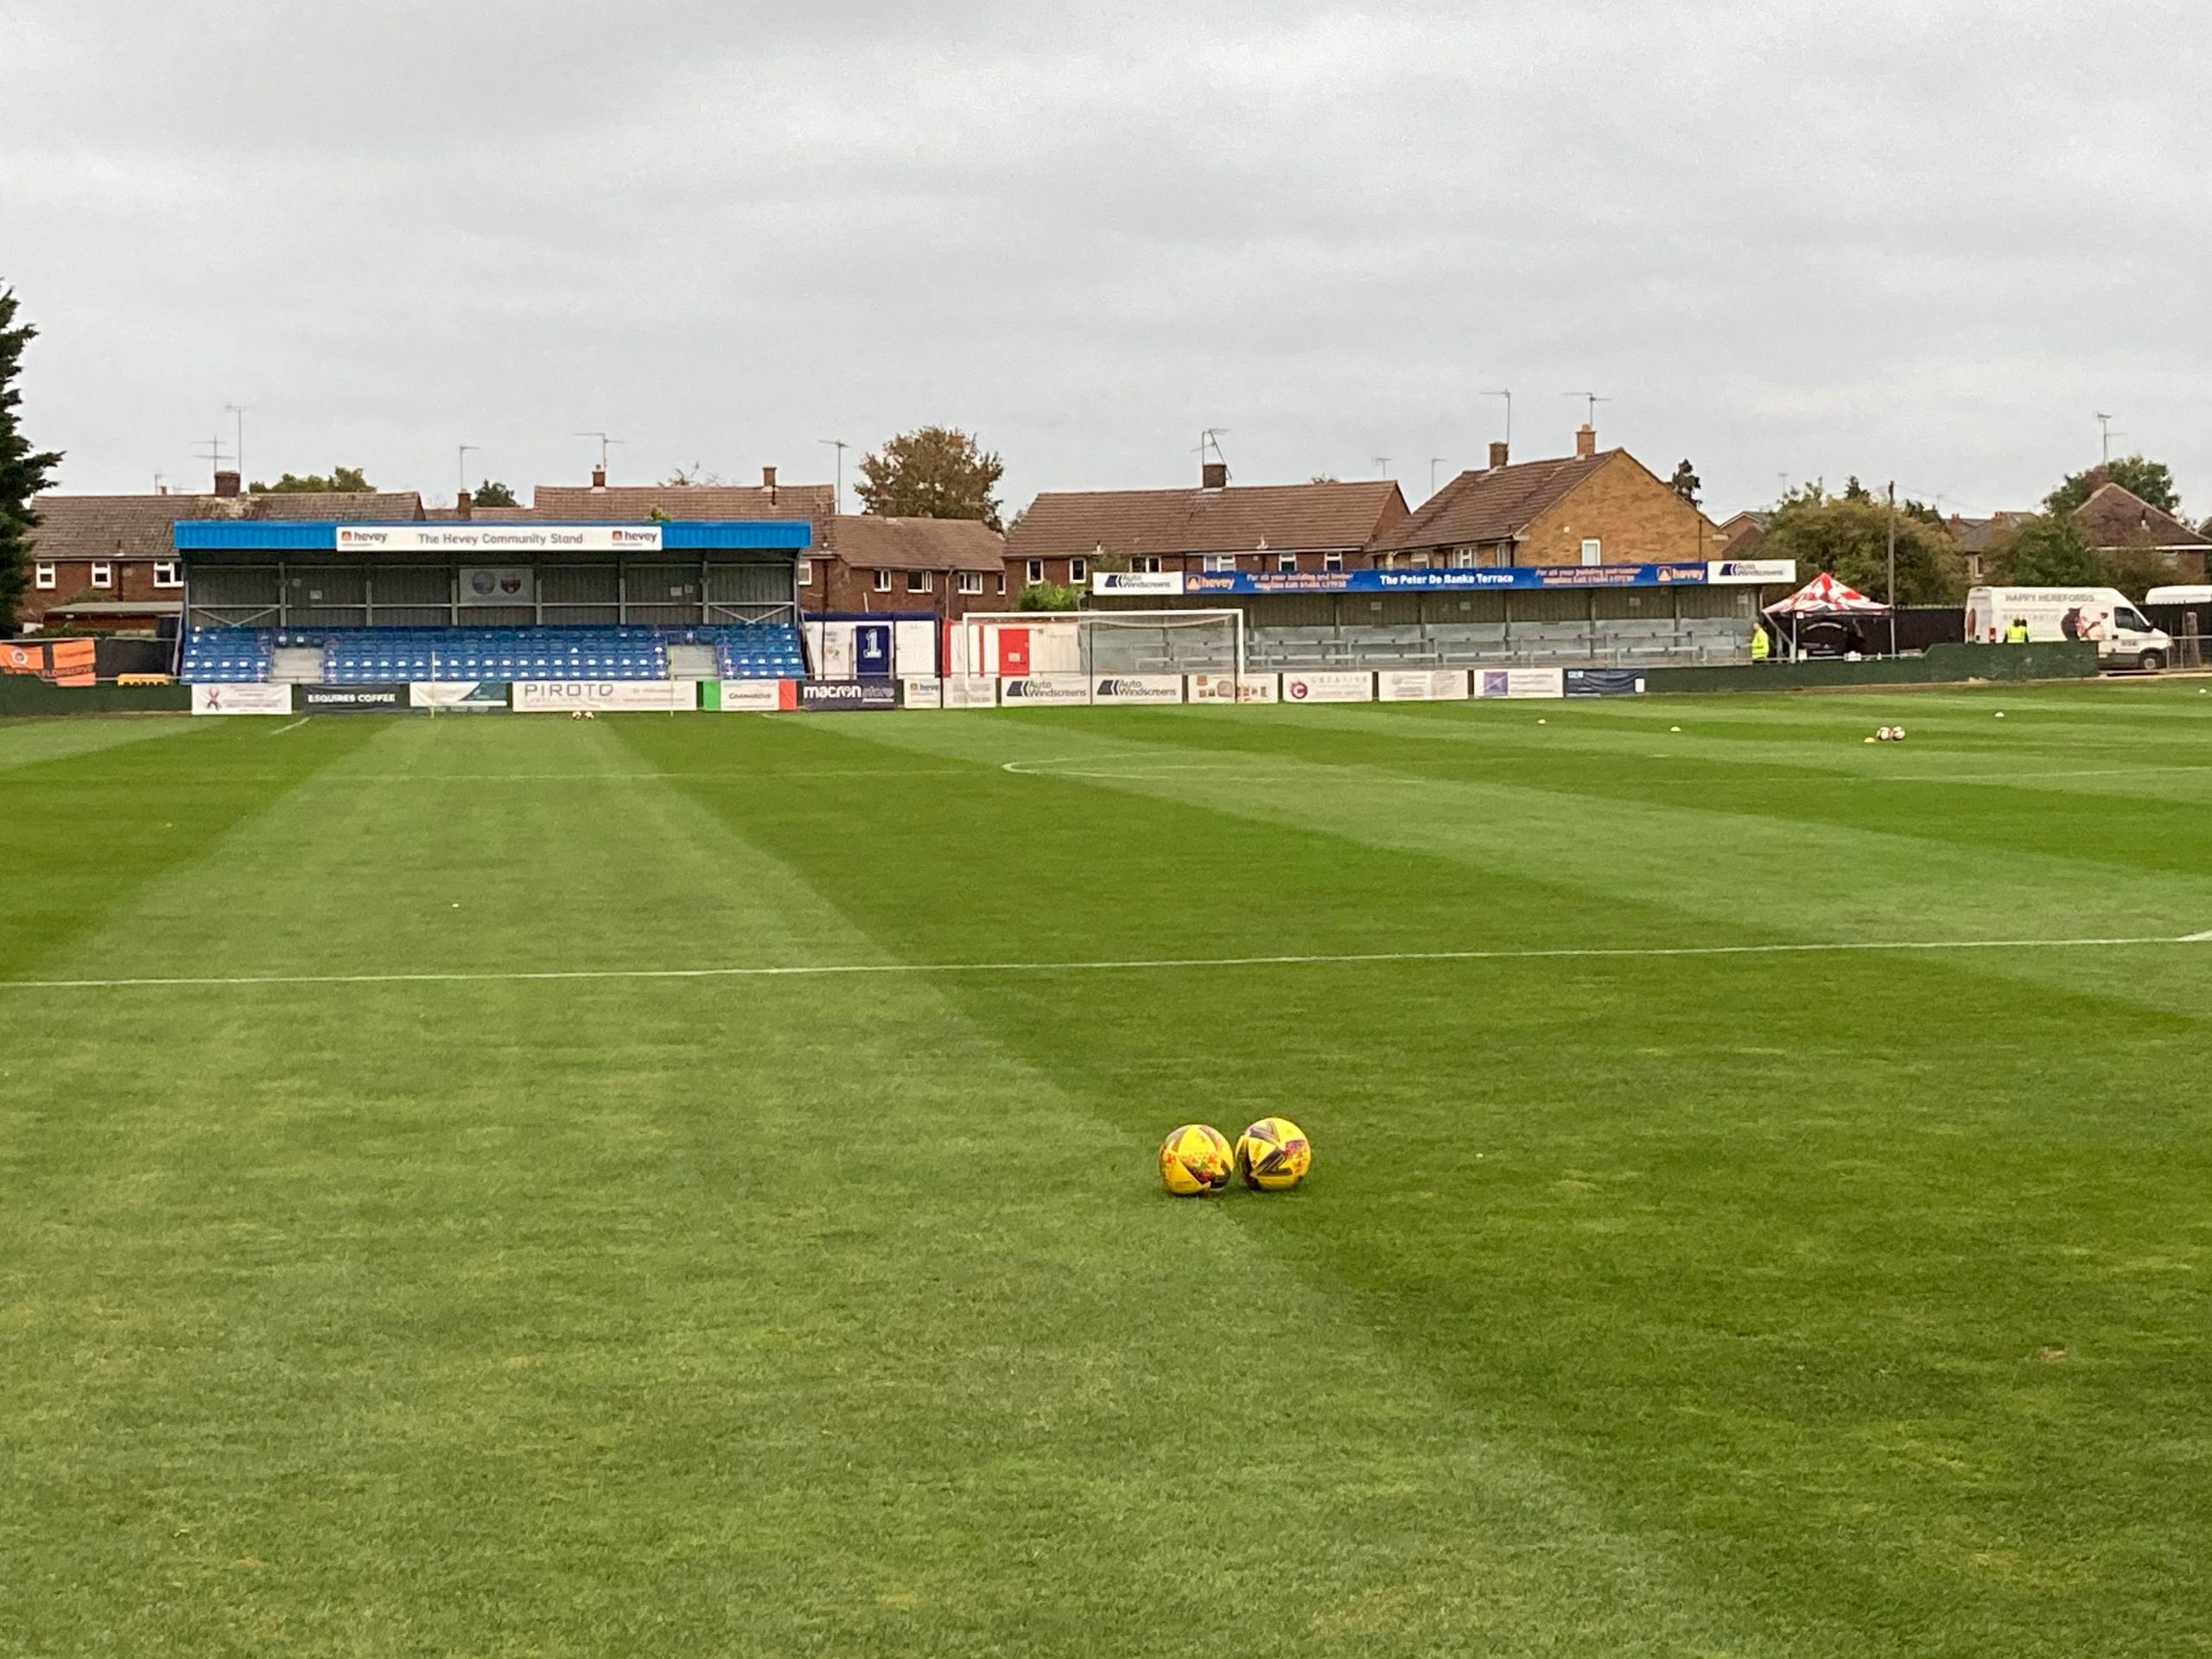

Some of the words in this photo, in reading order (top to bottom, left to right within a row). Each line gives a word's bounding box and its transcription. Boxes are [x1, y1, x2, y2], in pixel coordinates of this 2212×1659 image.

[354, 531, 388, 543] hevey
[418, 533, 439, 543] The
[443, 533, 478, 545] Hevey
[482, 533, 546, 546] Community
[550, 533, 583, 543] Stand
[625, 531, 658, 543] hevey
[1380, 575, 1398, 585] The
[1400, 575, 1427, 584] Peter
[1428, 575, 1442, 584] De
[1476, 573, 1515, 583] Terrace
[2005, 594, 2036, 602] HAPPY
[2038, 594, 2094, 602] HEREFORDS
[863, 628, 882, 658] 1
[524, 683, 613, 696] PIROTO
[1119, 679, 1141, 688] Auto
[803, 685, 861, 698] macron
[1029, 689, 1086, 697] Windscreens
[1119, 687, 1176, 696] Windscreens
[308, 694, 356, 702] ESQUIRES
